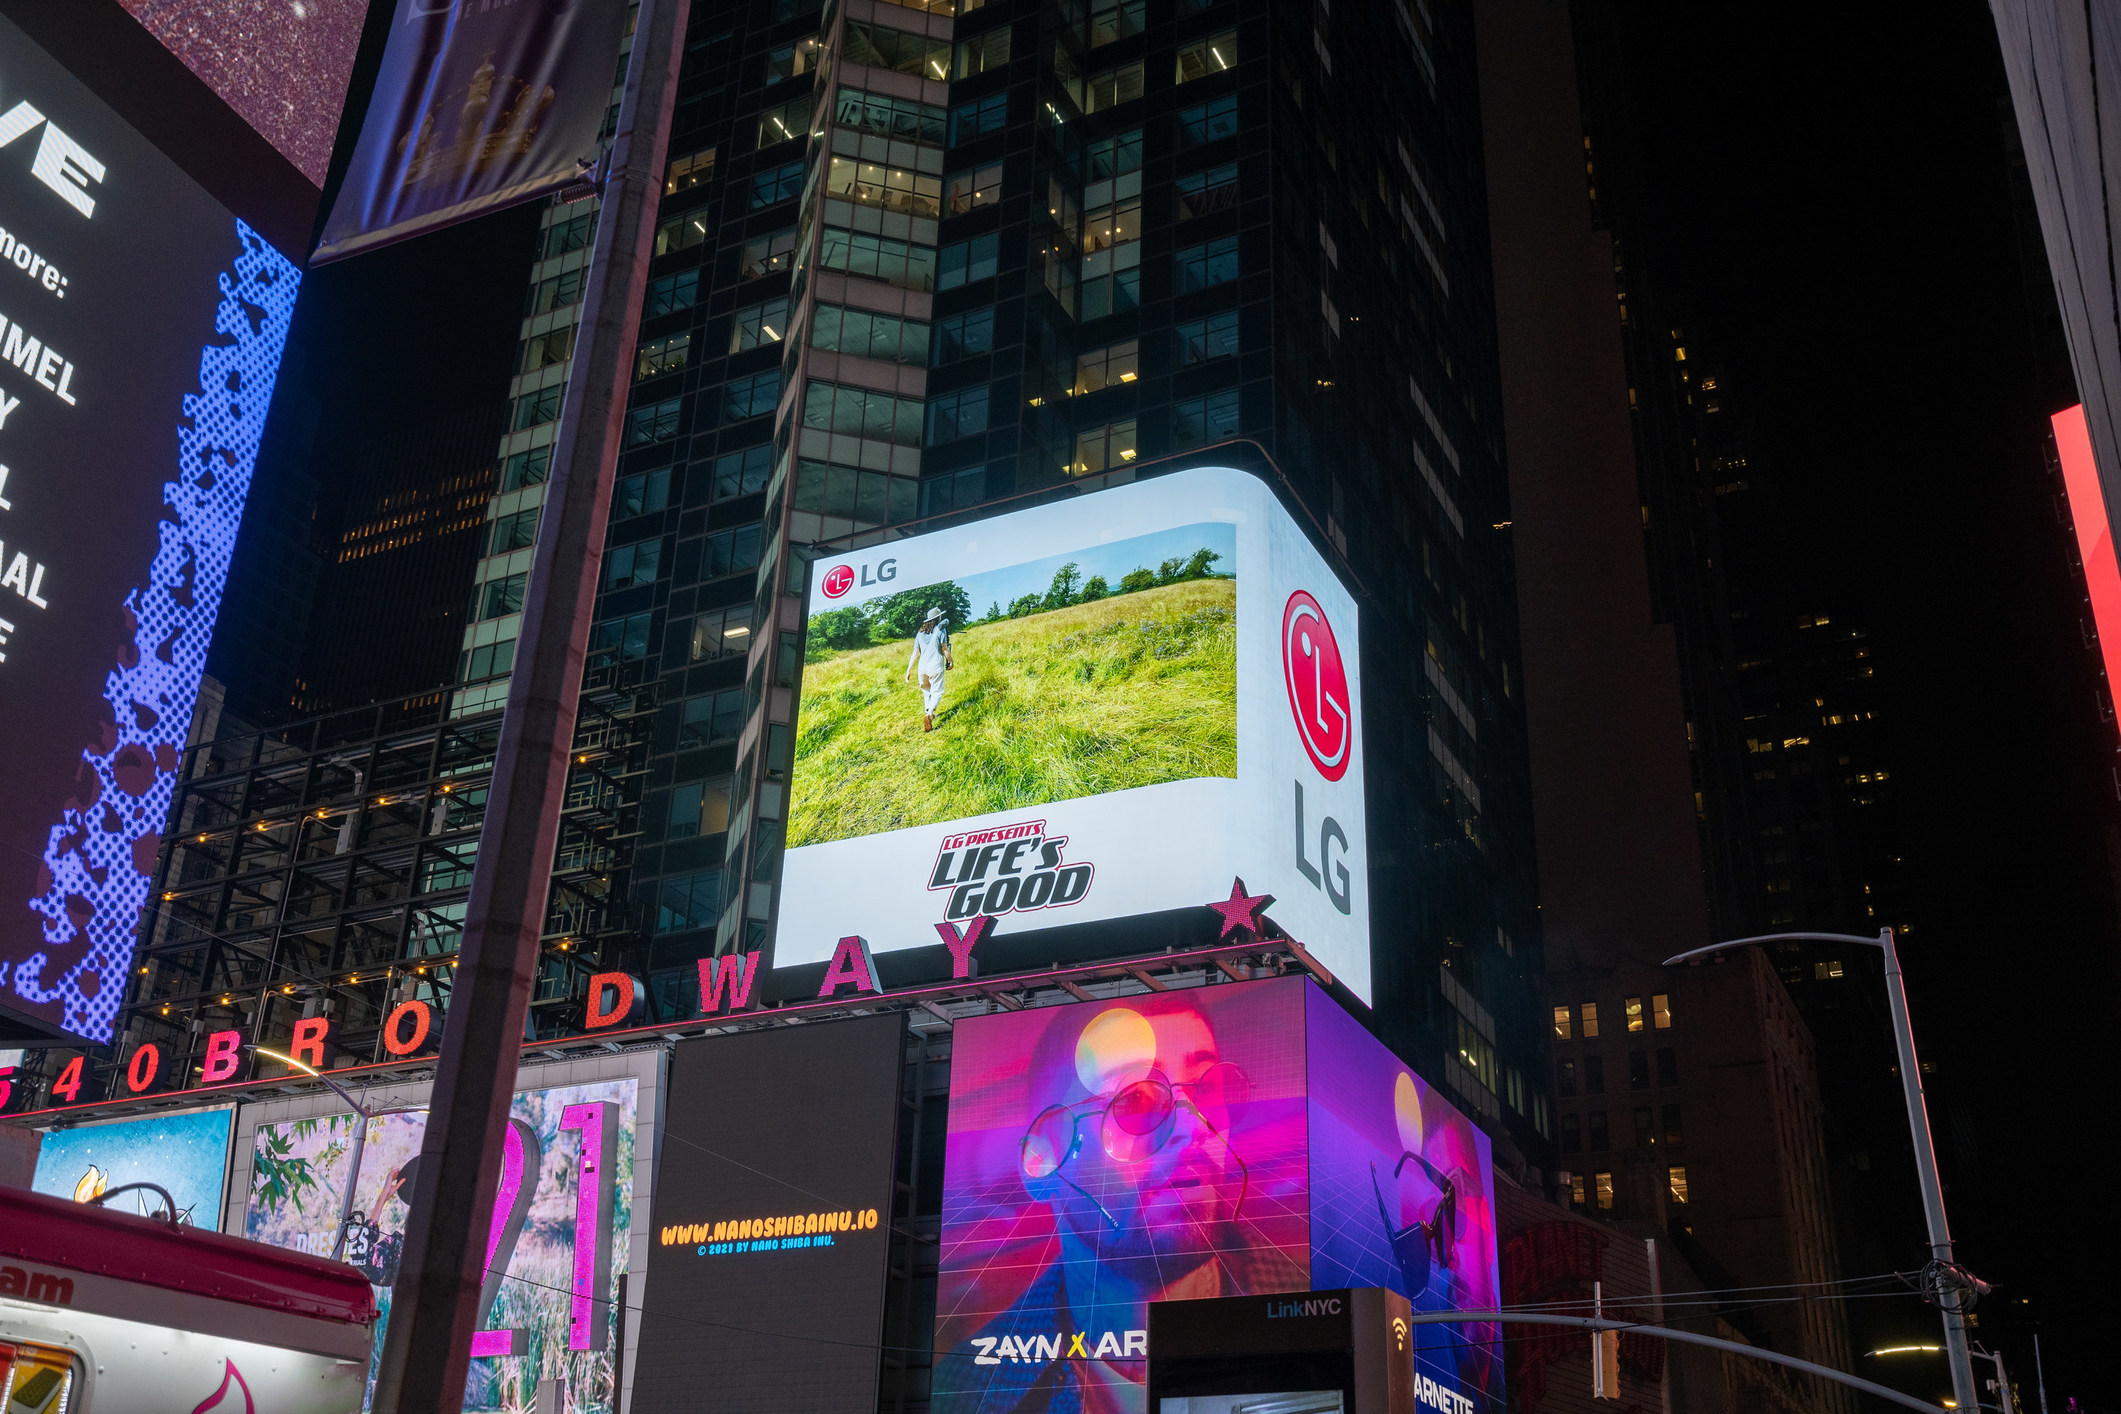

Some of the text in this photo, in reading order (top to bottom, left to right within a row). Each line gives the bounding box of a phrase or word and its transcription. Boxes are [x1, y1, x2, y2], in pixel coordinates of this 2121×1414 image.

[0, 540, 48, 610] AL
[861, 558, 897, 587] LG
[944, 823, 1043, 850] LG PRESENTS
[1295, 779, 1350, 915] LG
[931, 837, 1065, 887] LIFE'S
[947, 865, 1091, 920] GOOD
[661, 1208, 878, 1246] WWW.NANOSHIBAINU.IO
[736, 1241, 749, 1253] BY
[751, 1239, 779, 1252] NANO
[781, 1236, 811, 1249] SHIBA
[813, 1234, 835, 1247] INU.
[1267, 1298, 1342, 1319] LinkNYC
[970, 1332, 1063, 1365] ZAYN
[1066, 1331, 1087, 1358] X
[1413, 1372, 1474, 1414] ARNETTE
